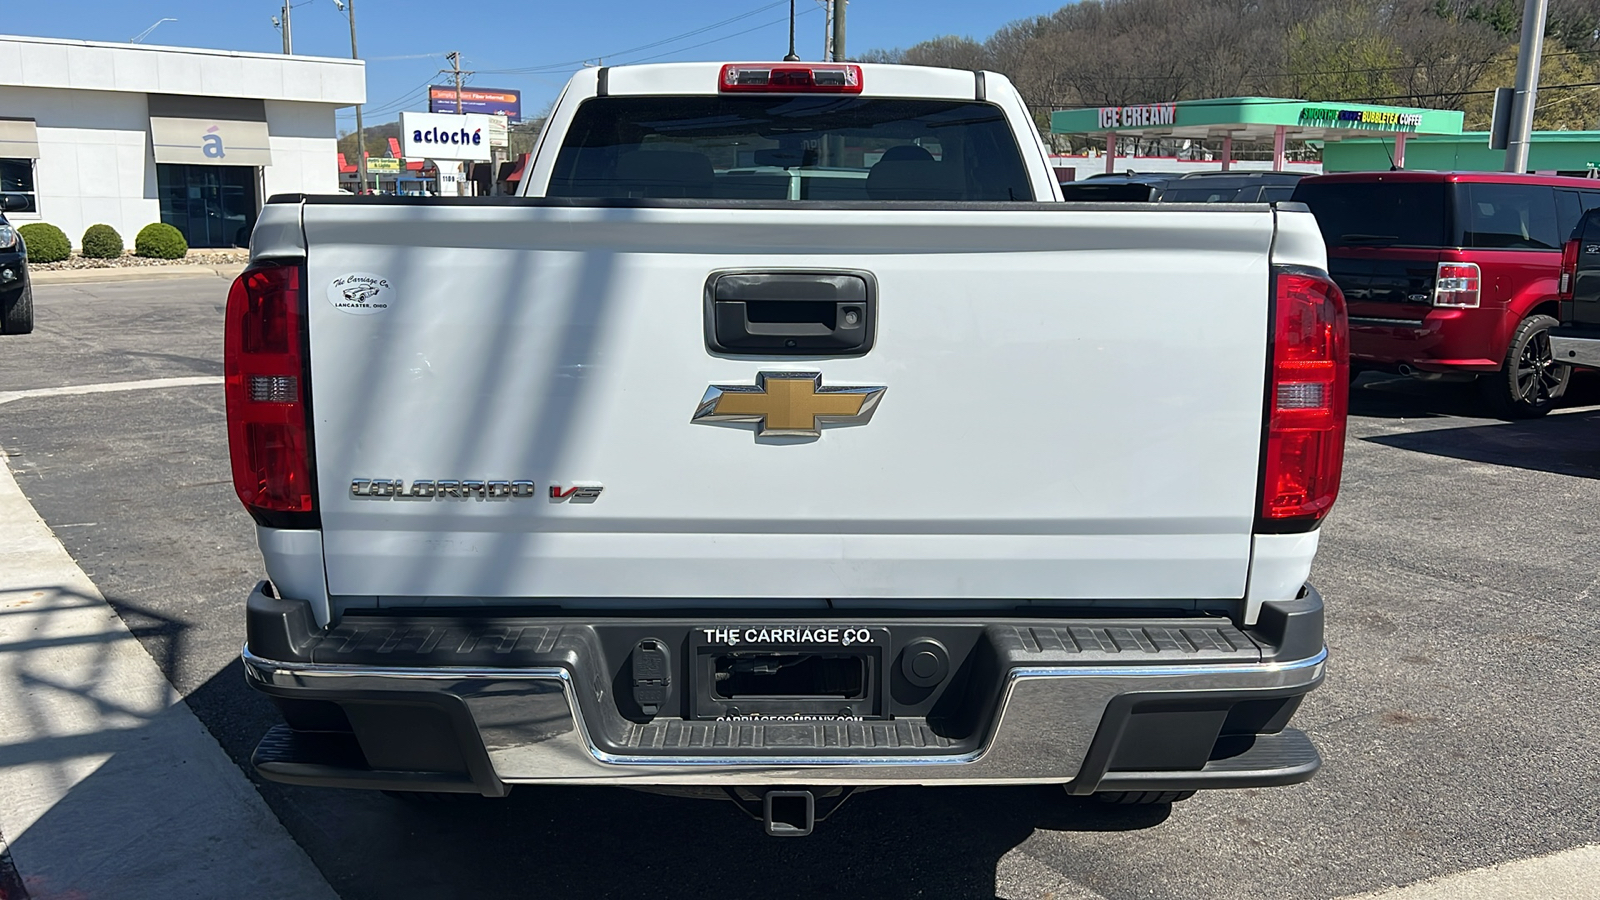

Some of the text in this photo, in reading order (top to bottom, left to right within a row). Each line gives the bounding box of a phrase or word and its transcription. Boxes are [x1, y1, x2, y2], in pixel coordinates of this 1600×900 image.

[1098, 103, 1176, 128] ICE CREAM
[1399, 113, 1422, 126] COFFEE
[413, 127, 482, 145] acloché
[333, 275, 391, 290] The Carriage Co.
[350, 478, 604, 504] COLORADO V6
[703, 629, 875, 644] THE CARRIAGE CO.
